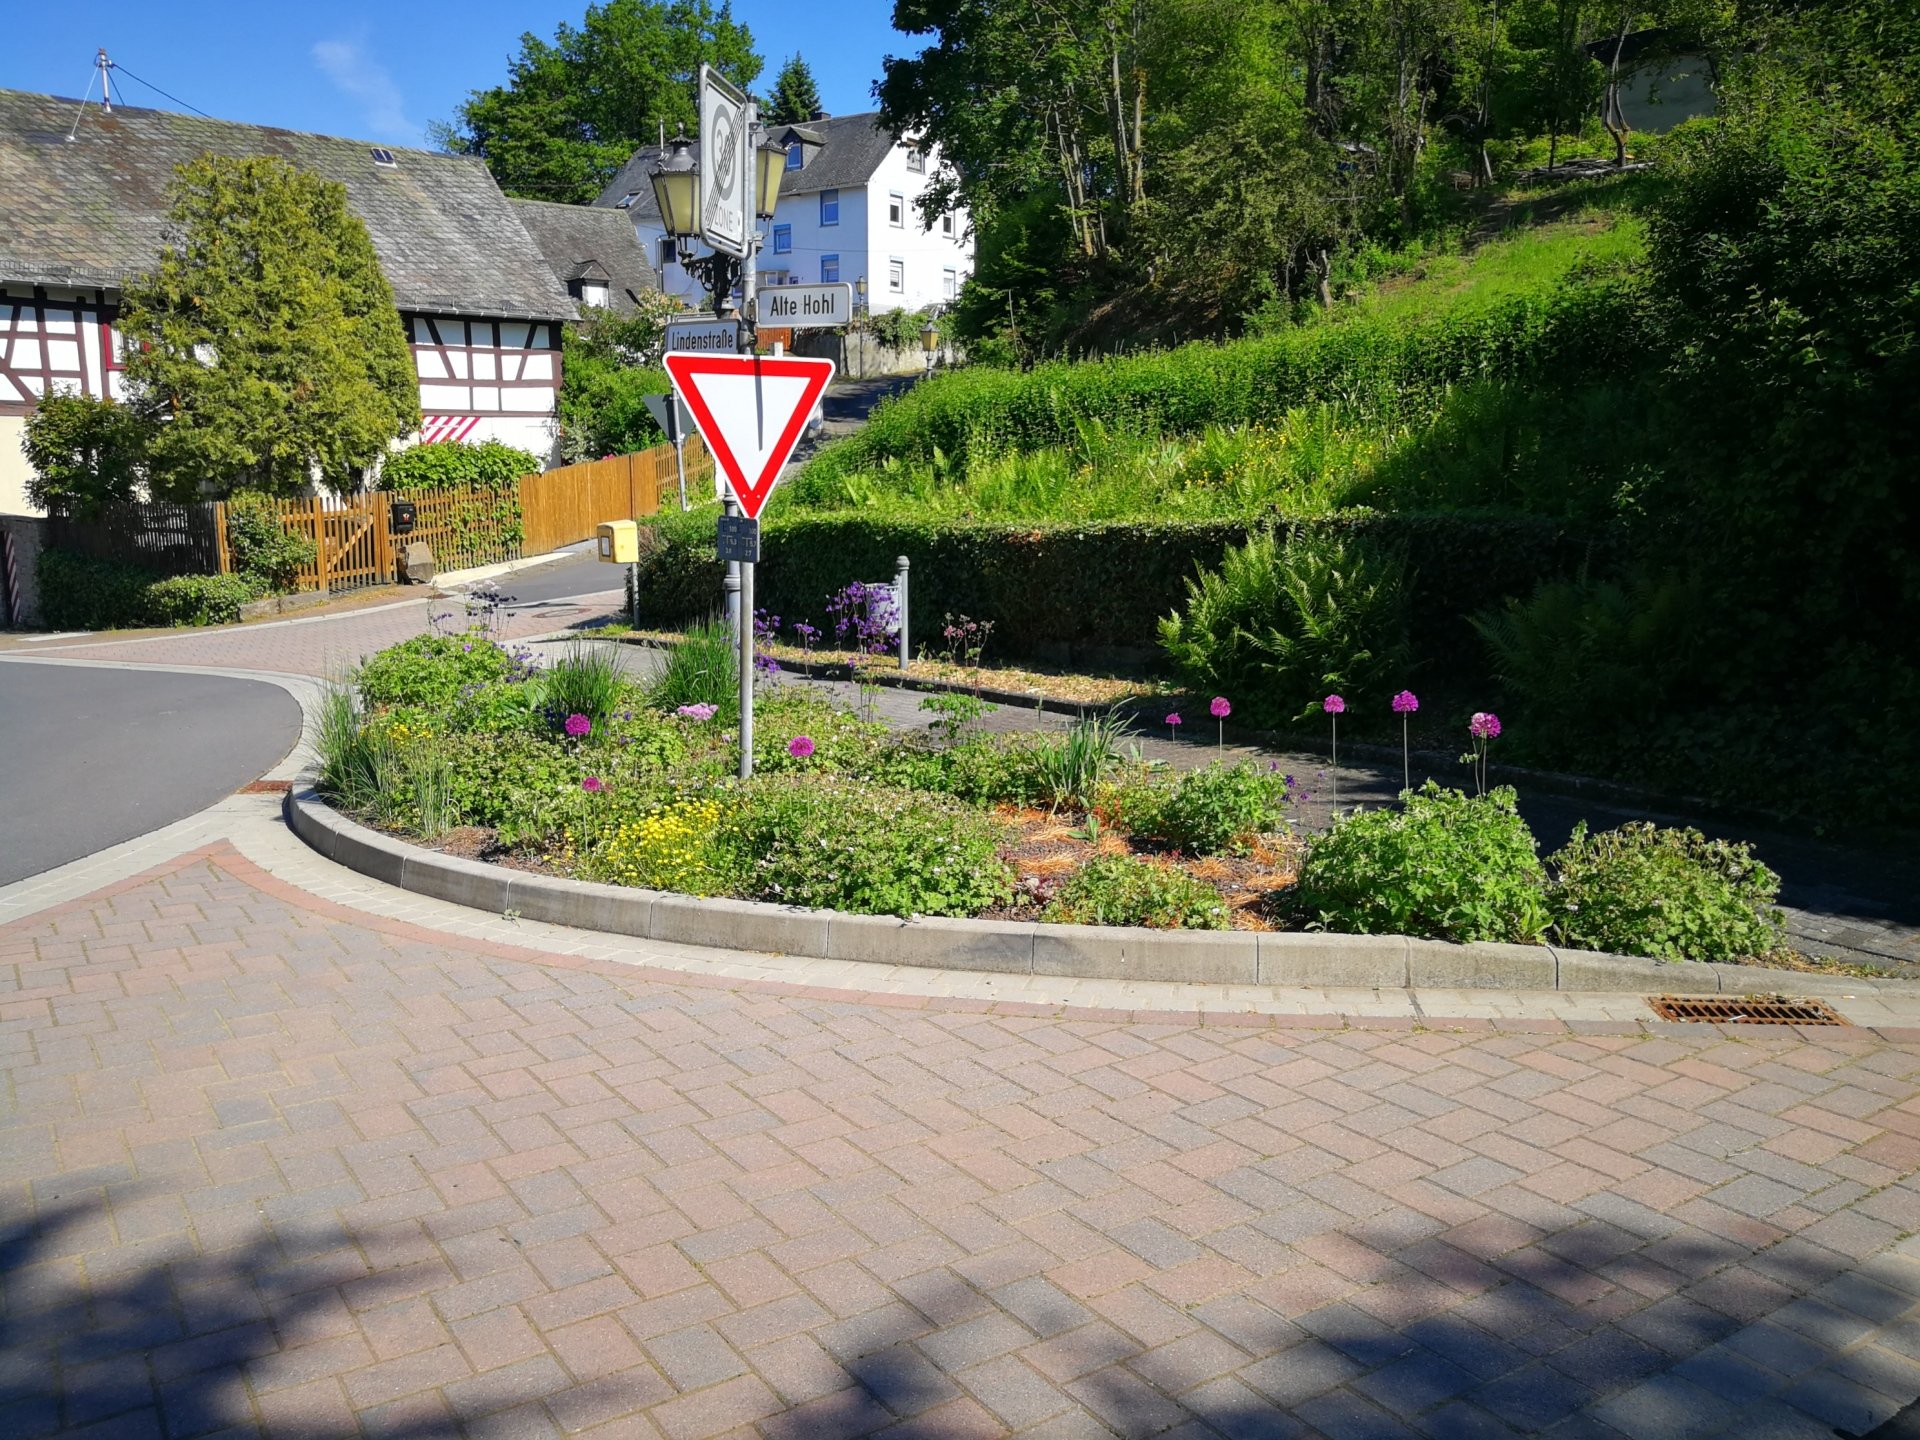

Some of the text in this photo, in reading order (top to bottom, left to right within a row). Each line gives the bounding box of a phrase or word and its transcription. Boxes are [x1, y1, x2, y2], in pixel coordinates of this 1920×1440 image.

[714, 204, 734, 232] ZONE
[770, 293, 834, 316] Alte Hohl
[672, 329, 733, 350] Lindenstraße
